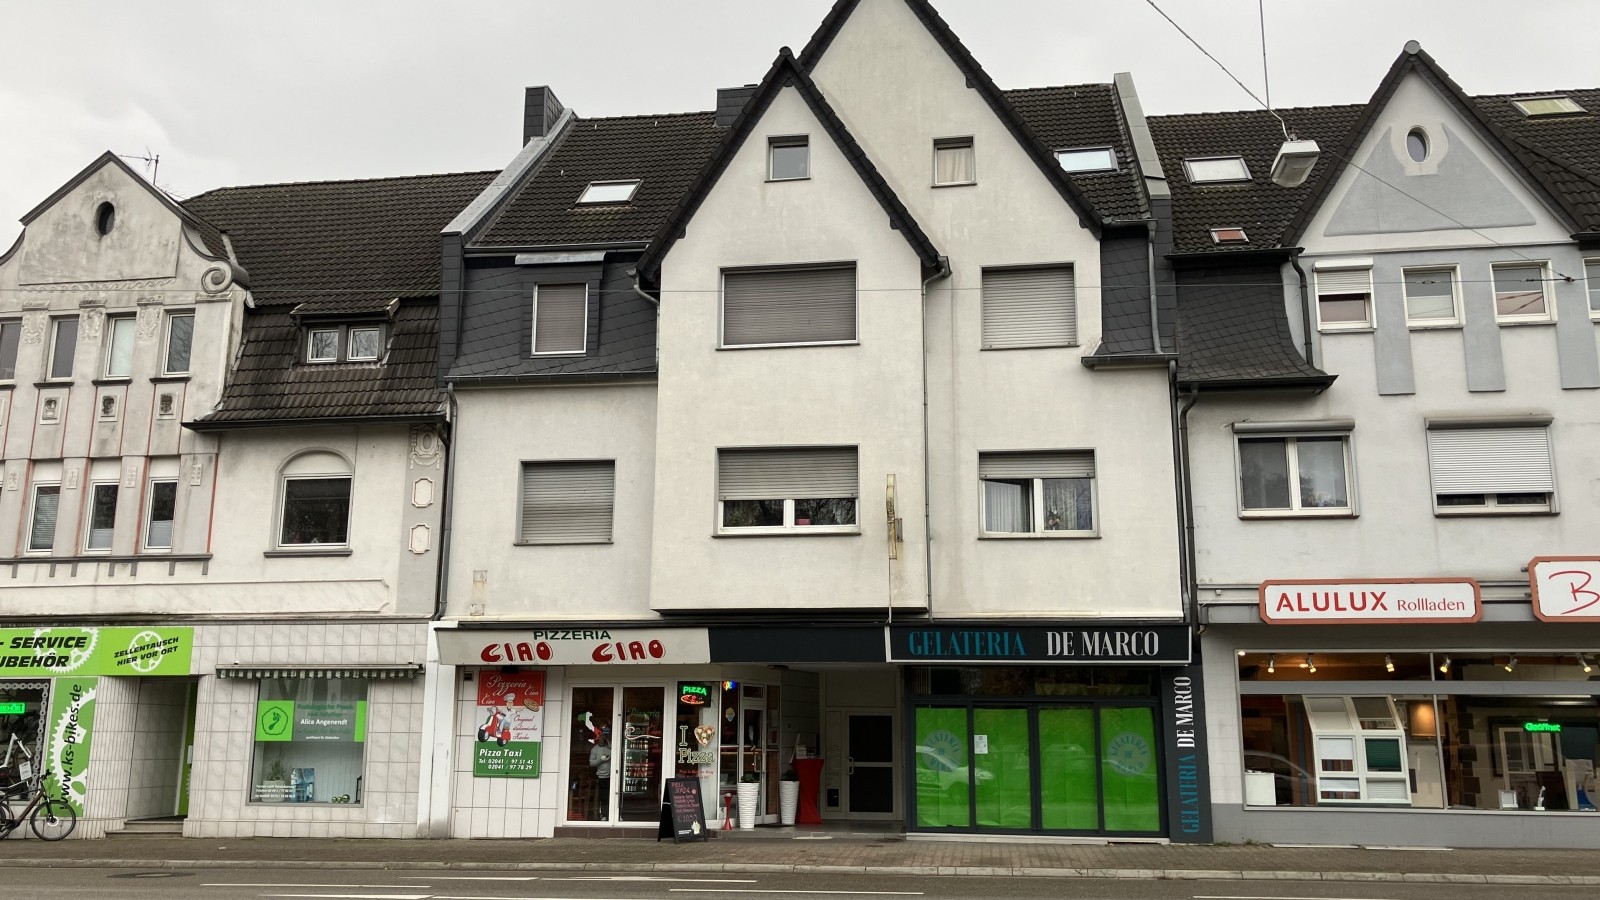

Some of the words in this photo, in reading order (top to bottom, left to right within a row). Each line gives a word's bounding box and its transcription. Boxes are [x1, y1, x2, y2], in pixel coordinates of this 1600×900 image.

[1276, 591, 1388, 612] ALULUX
[1397, 598, 1465, 612] Rollladen
[10, 637, 87, 648] SERVICE
[533, 630, 611, 640] PIZZERIA
[908, 630, 1026, 657] GELATERIA
[1046, 631, 1074, 657] DE
[1081, 631, 1159, 656] MARCO
[114, 637, 179, 658] ZELLENTAUSCH
[117, 656, 138, 666] HIER
[141, 651, 158, 660] VOR
[161, 646, 178, 655] ORT
[480, 642, 553, 663] CIAO
[592, 639, 666, 663] CIAO
[487, 674, 527, 696] Pizzeria
[683, 686, 707, 696] PIZZA
[1173, 676, 1194, 726] MARCO
[315, 719, 348, 727] Angenendt
[1525, 722, 1562, 732] Geöffnet
[679, 725, 688, 747] I
[1176, 729, 1196, 748] DE
[480, 749, 501, 757] Pizza
[504, 749, 523, 757] Taxi
[678, 747, 716, 765] Pizza
[1178, 754, 1200, 833] GELATERIA
